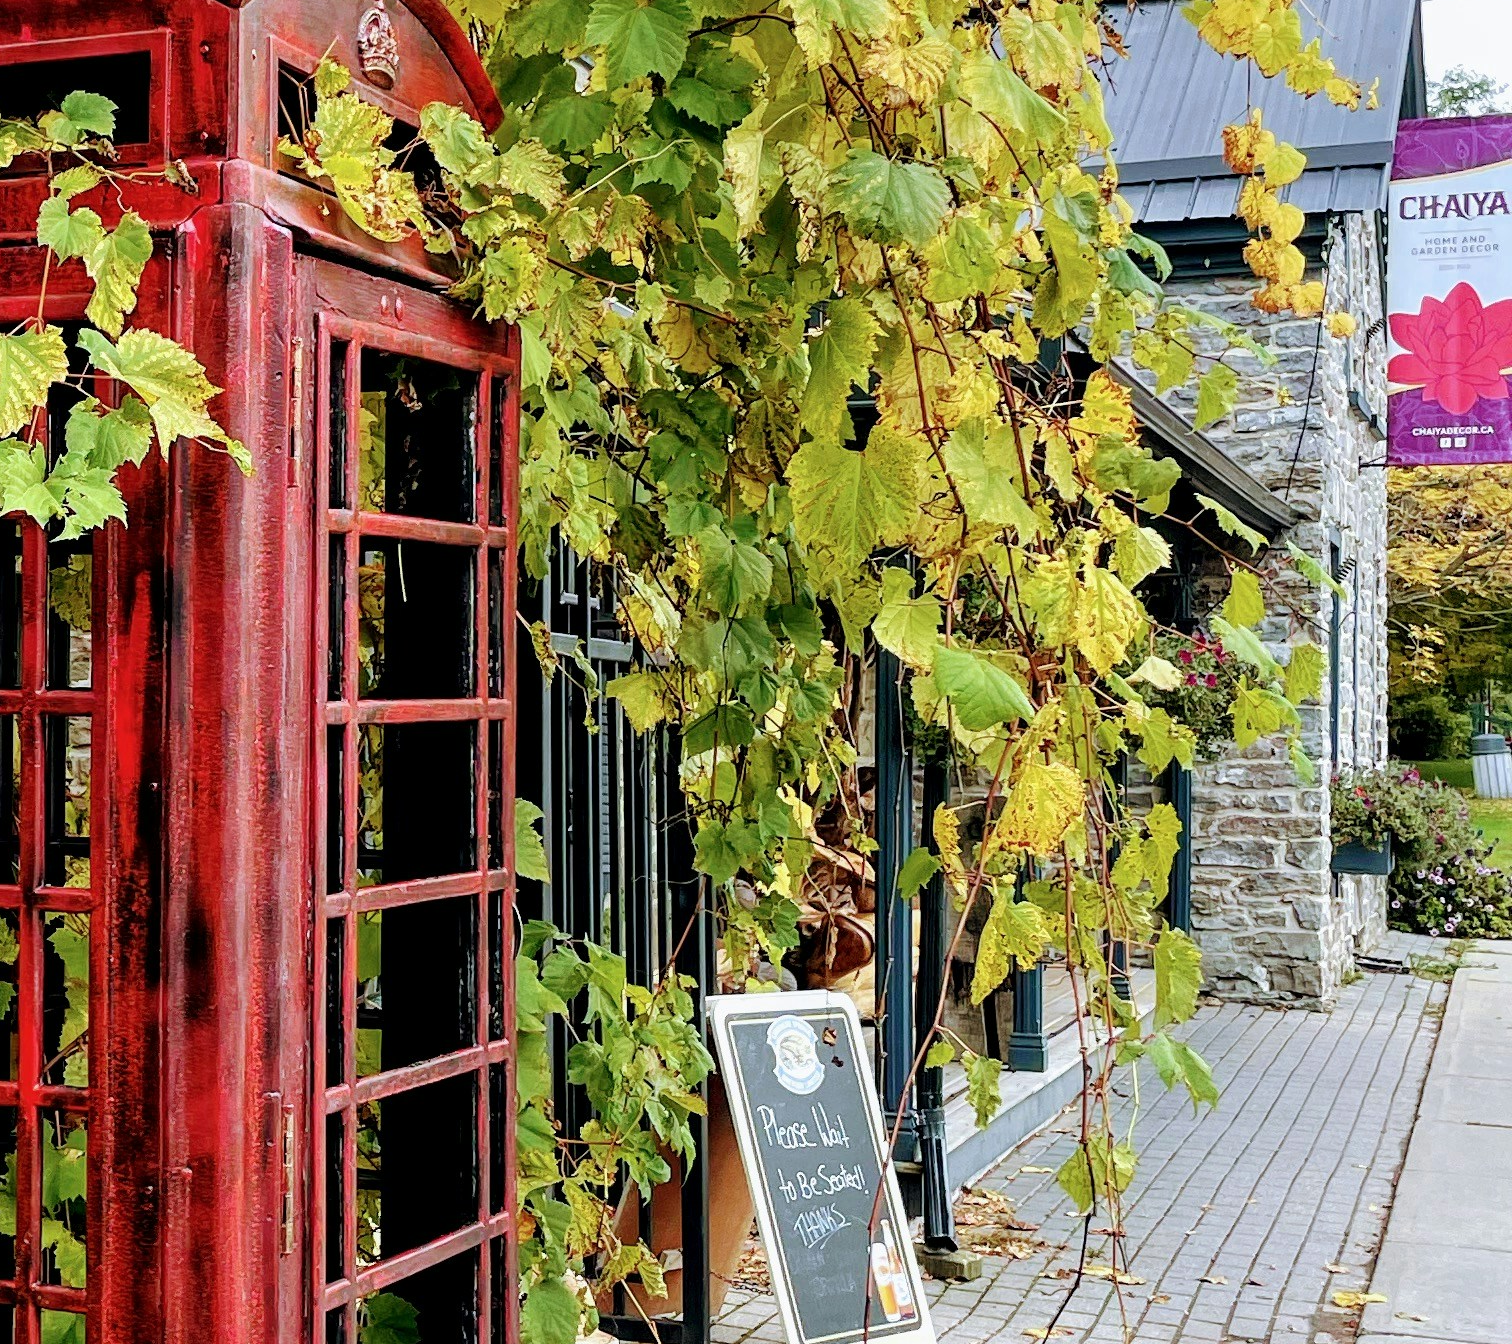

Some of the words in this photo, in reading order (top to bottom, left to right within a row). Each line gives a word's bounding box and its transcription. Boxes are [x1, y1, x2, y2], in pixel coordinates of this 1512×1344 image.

[1399, 191, 1510, 221] CHAIYA
[1411, 246, 1457, 256] GARDEN
[1461, 243, 1500, 253] DECOR
[1424, 236, 1458, 246] HOME
[1461, 235, 1486, 244] AND
[1412, 425, 1494, 436] CHAIYADECOR.CA
[756, 1105, 817, 1149] Please
[811, 1102, 850, 1149] Wait
[777, 1168, 797, 1204] to
[796, 1171, 822, 1200] Be
[793, 1203, 849, 1247] THANKS
